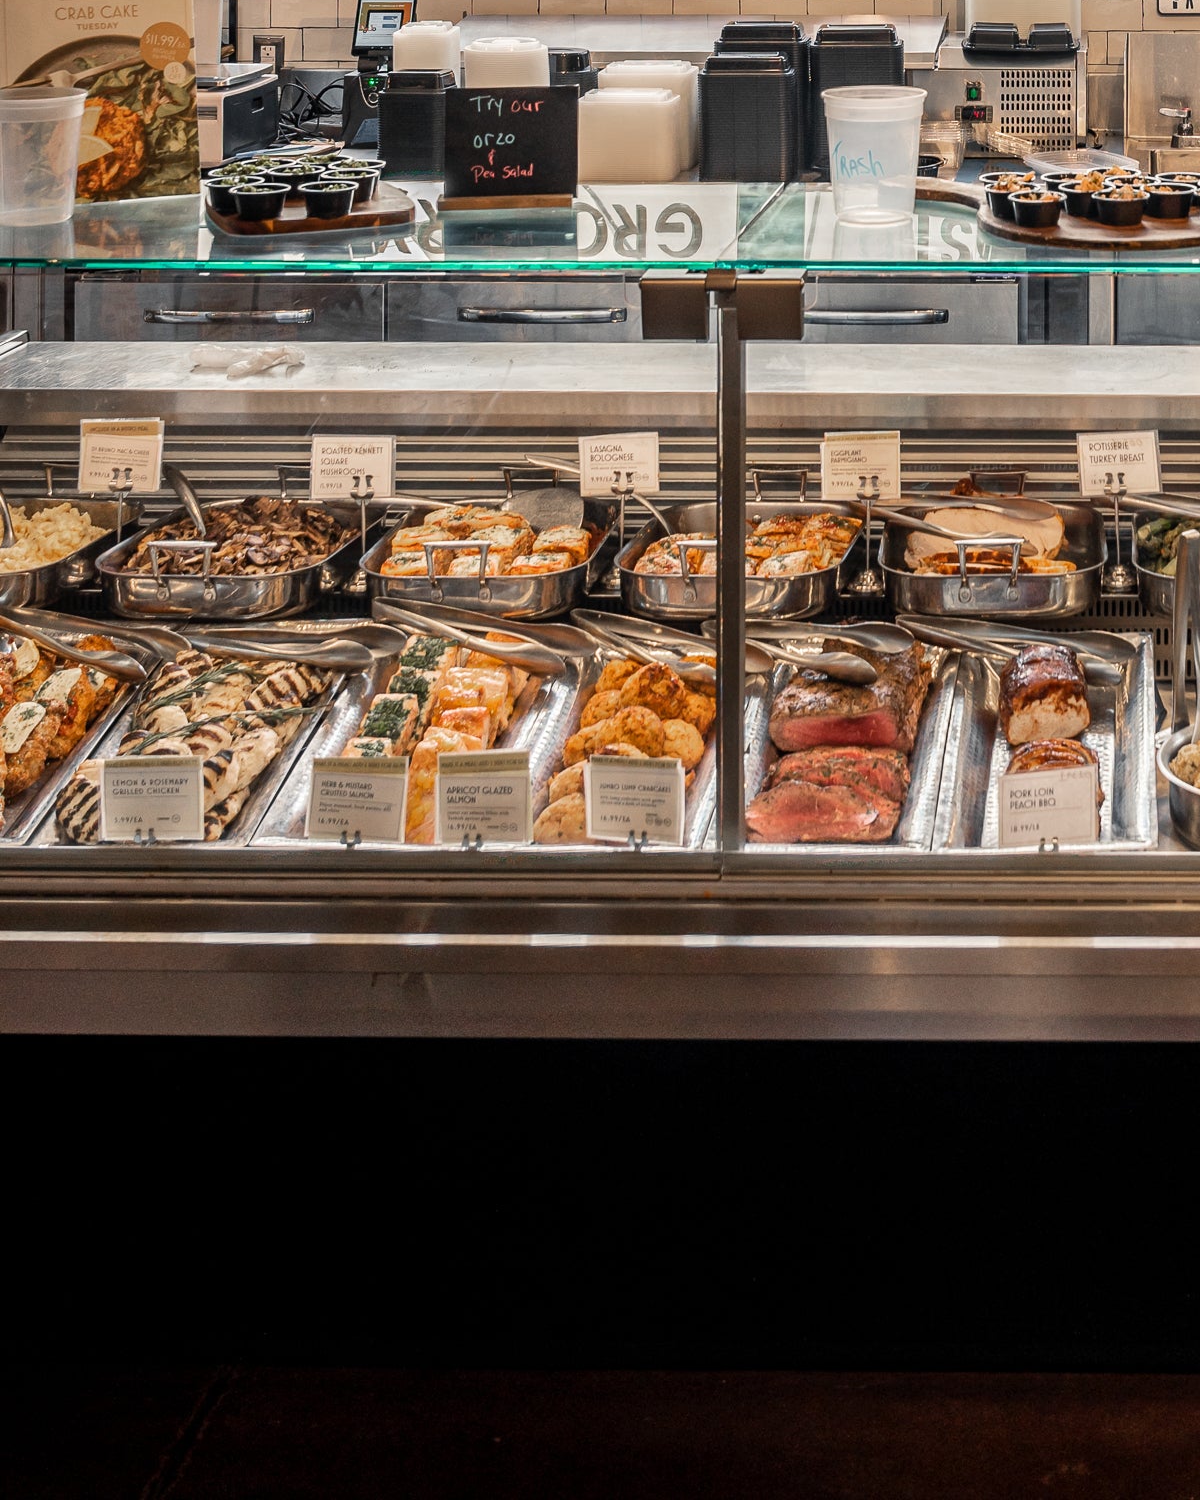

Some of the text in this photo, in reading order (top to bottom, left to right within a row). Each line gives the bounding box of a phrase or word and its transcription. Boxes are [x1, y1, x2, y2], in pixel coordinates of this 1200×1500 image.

[55, 4, 139, 20] CRAB CAKE
[77, 21, 119, 31] TUESDAY
[469, 95, 544, 116] Try our
[470, 163, 534, 183] Pea Salad
[590, 445, 623, 453] LASAGNA
[1089, 441, 1129, 451] ROTISSERIE
[321, 447, 384, 455] ROASTED KENNETT
[321, 457, 348, 465] SQUARE
[590, 453, 634, 461] BOLOGNESE
[1089, 453, 1144, 464] TURKEY BREAST
[320, 468, 365, 476] MUSHROOMS
[112, 779, 138, 787] LEMON
[149, 778, 189, 786] ROSEMARY
[112, 787, 180, 795] GRILLED CHICKEN
[446, 785, 513, 795] APRICOT GLAZED
[1009, 787, 1054, 799] PORK LOIN
[349, 791, 375, 799] SALMON
[446, 795, 477, 804] SALMON
[1009, 797, 1056, 810] PEACH BBQ
